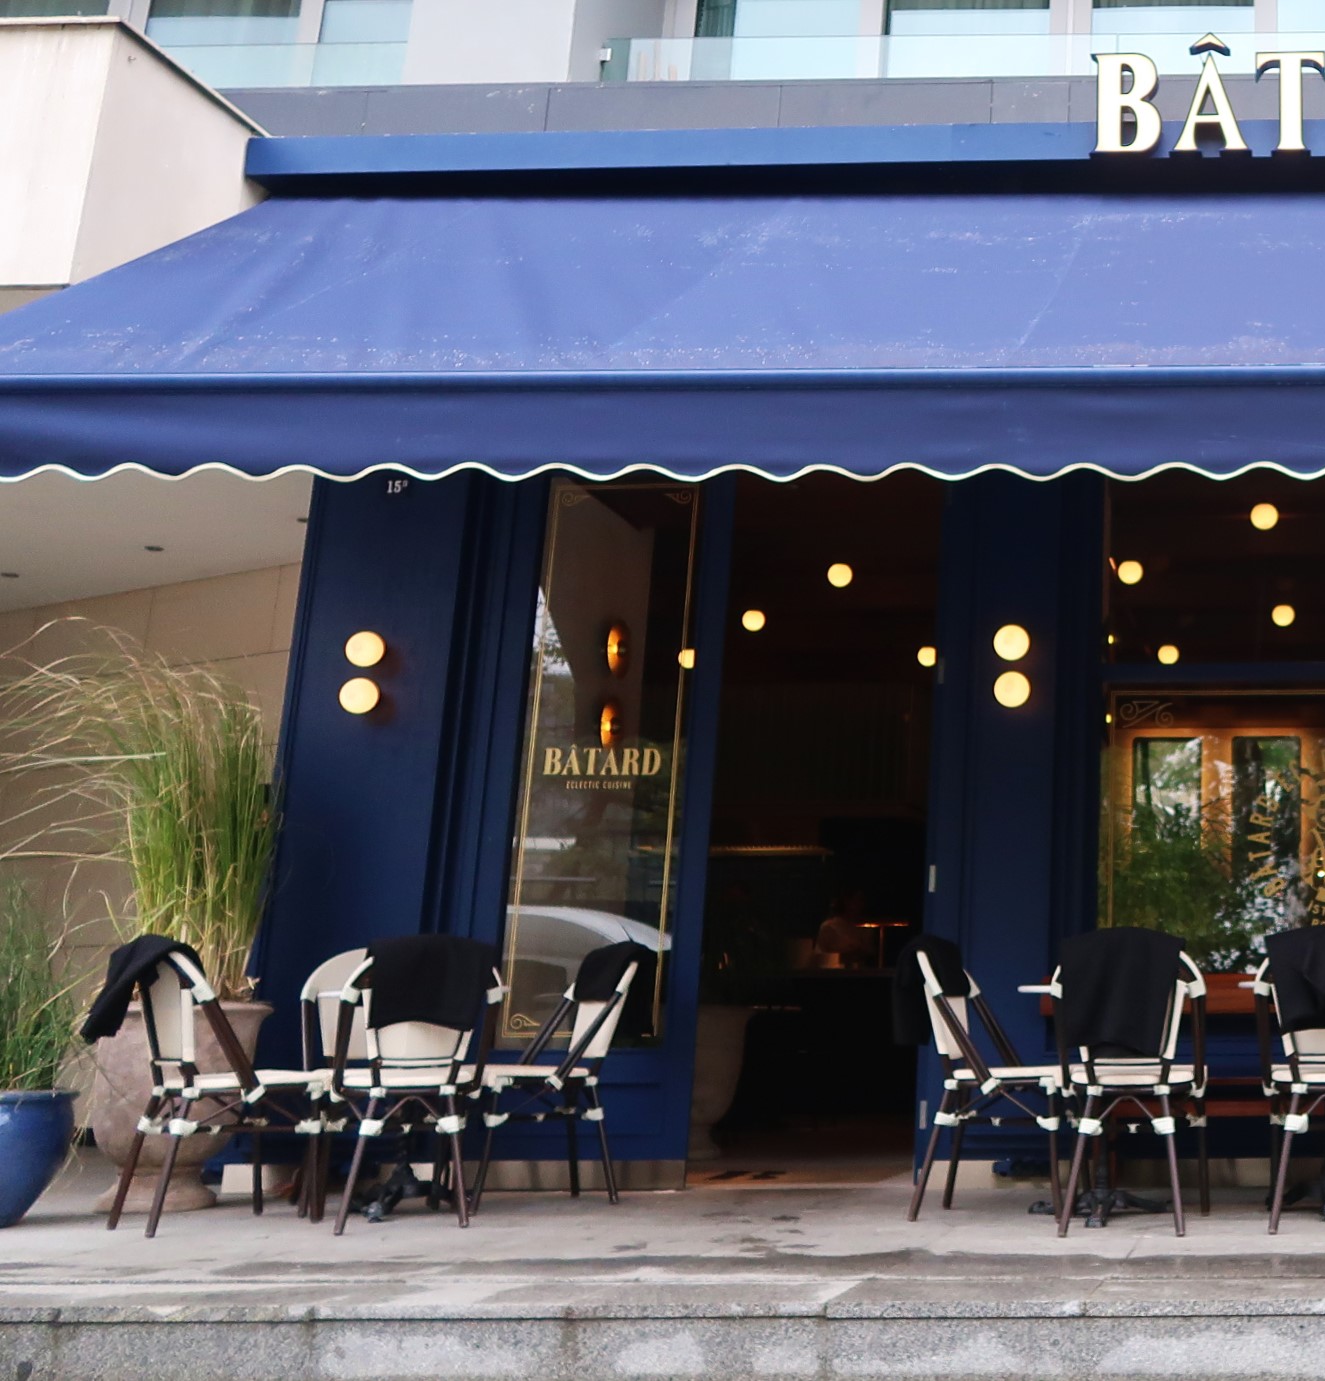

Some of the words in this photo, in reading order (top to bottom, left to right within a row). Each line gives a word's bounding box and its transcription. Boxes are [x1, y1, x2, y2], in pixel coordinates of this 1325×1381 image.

[543, 744, 661, 775] BÂTARD
[566, 780, 600, 790] ECLECTIC
[602, 780, 631, 790] CUISINE
